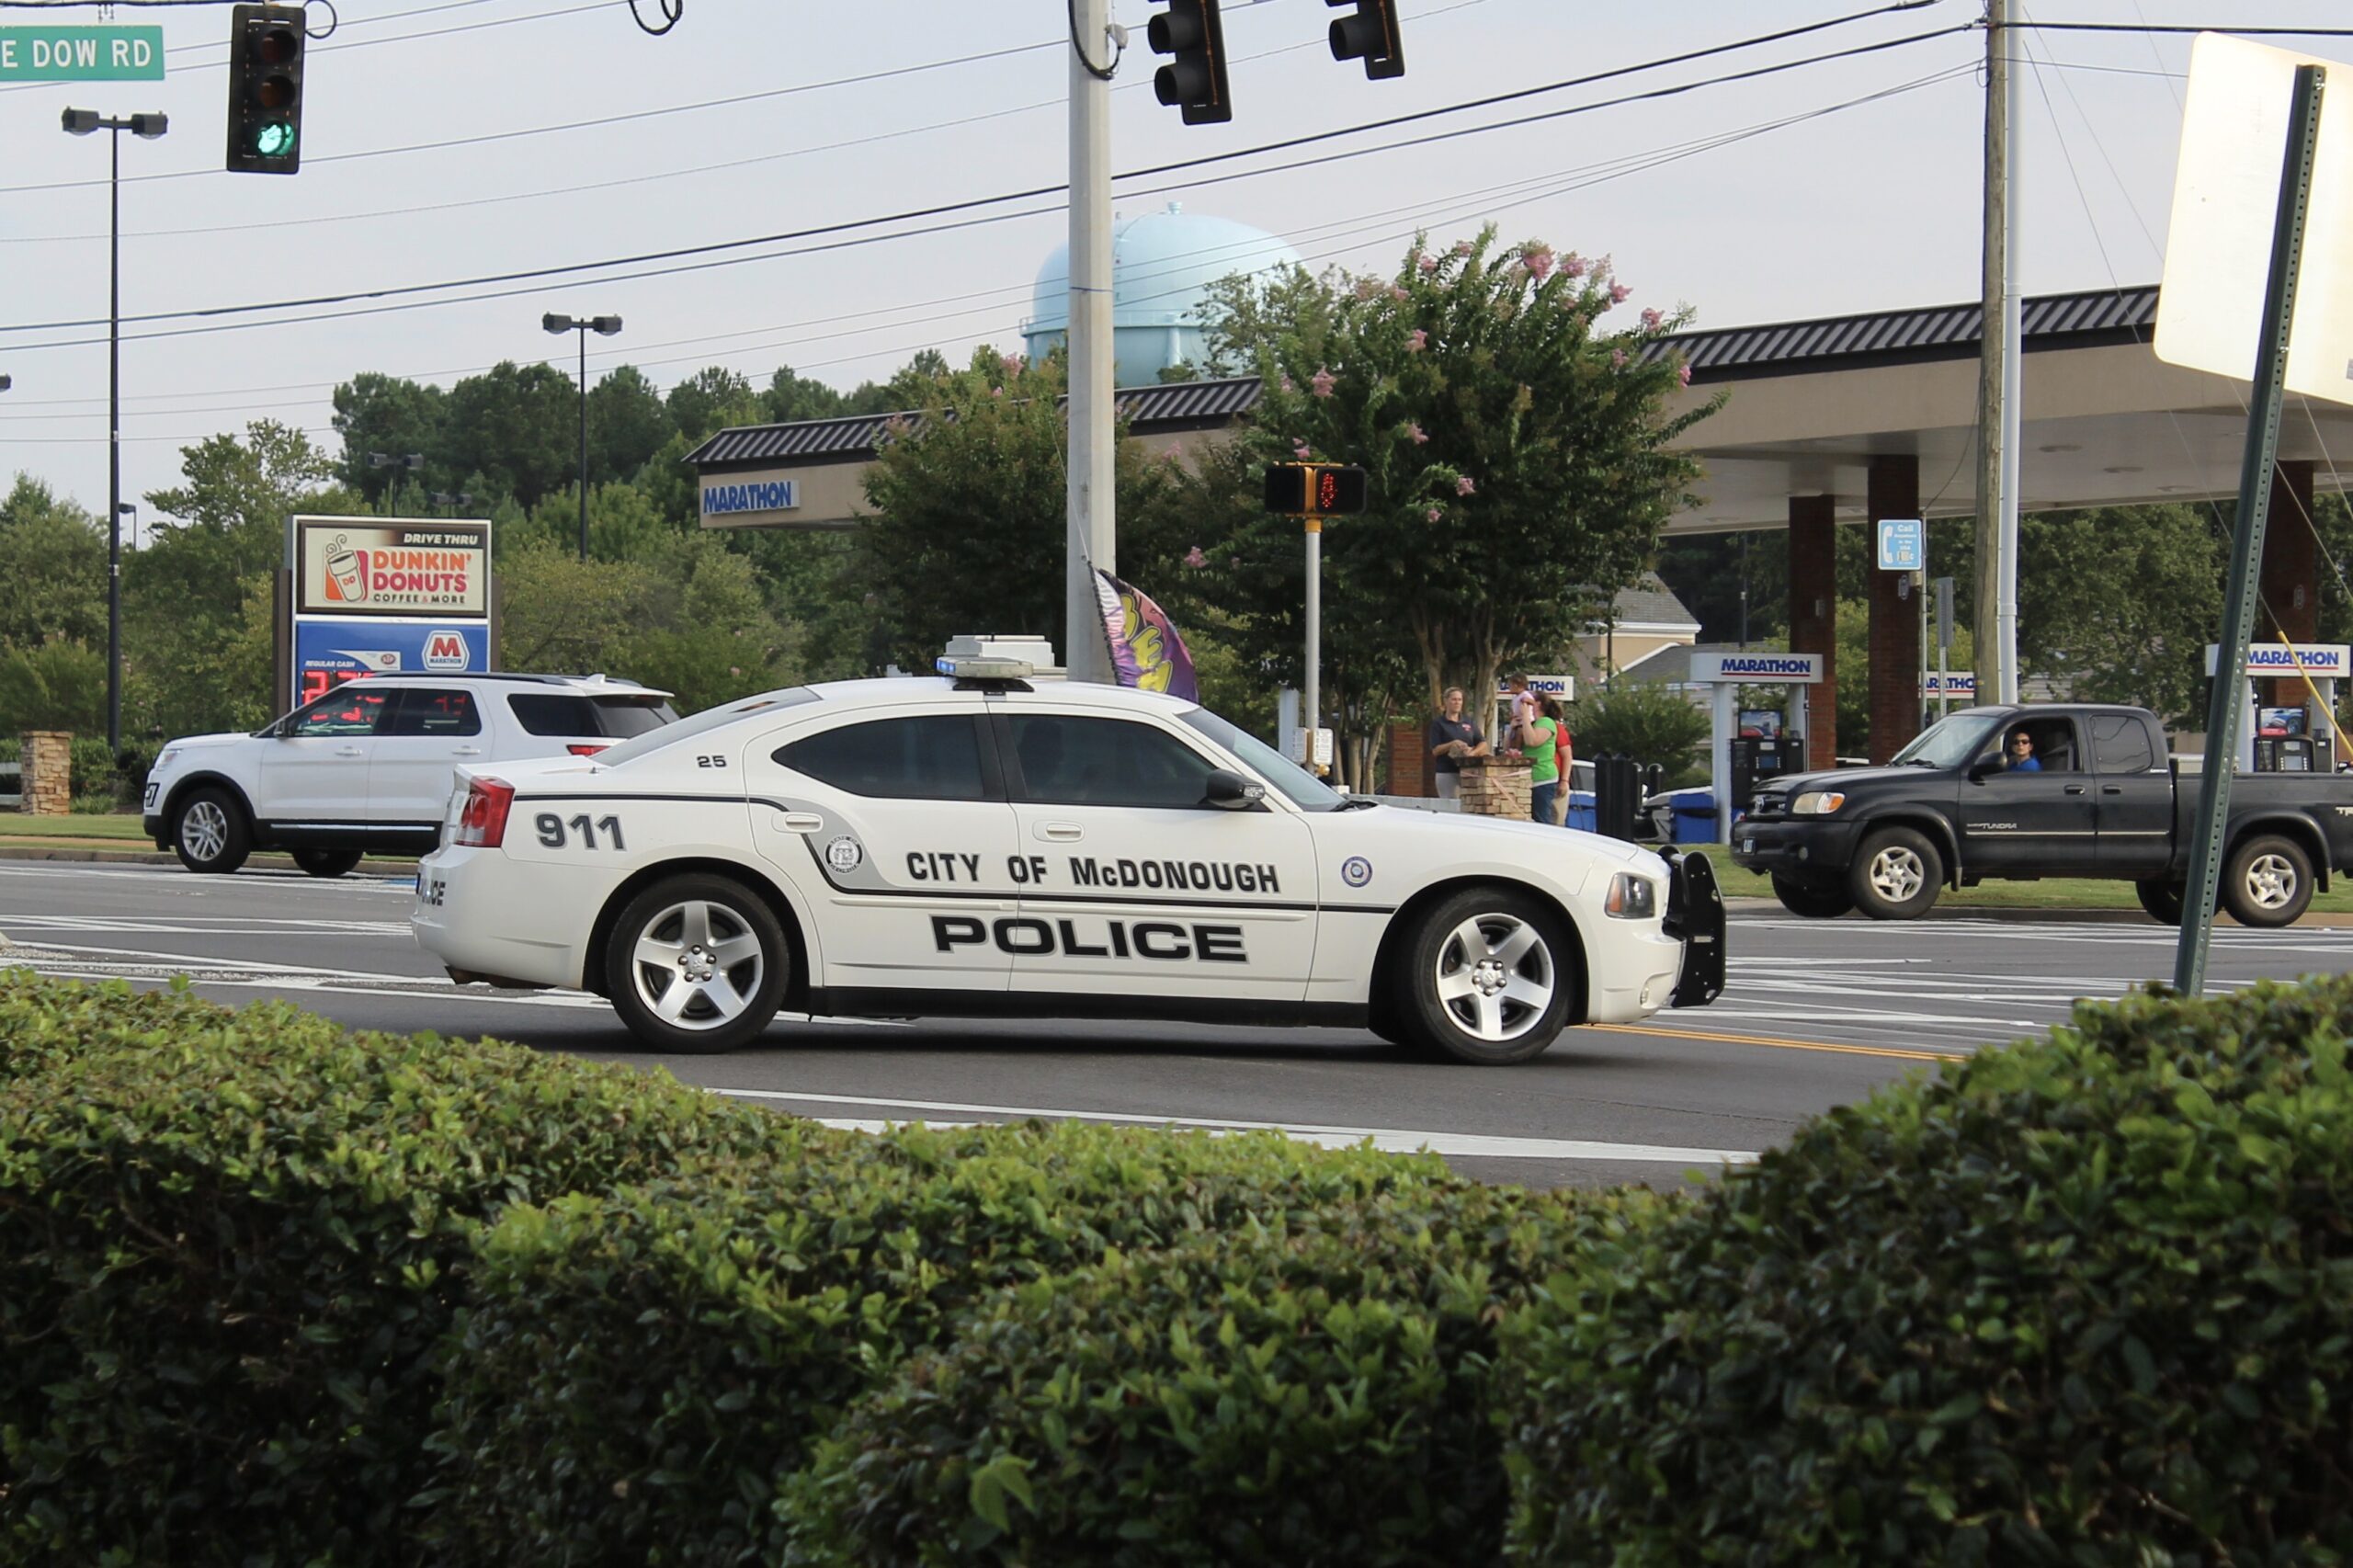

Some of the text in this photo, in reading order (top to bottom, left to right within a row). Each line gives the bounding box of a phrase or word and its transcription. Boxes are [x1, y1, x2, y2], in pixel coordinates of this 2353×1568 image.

[1, 40, 152, 68] E DOW RD
[703, 481, 791, 513] MARATHON
[404, 533, 478, 545] DRIVE THRU
[373, 551, 472, 572] DUNKIN'
[373, 572, 467, 593] DONUTS
[373, 594, 419, 603] COFFEE
[431, 596, 465, 604] MORE
[1721, 658, 1811, 673] MARATHON
[697, 756, 727, 767] 25
[534, 812, 627, 851] 911
[905, 852, 1281, 894] CITY OF McDONOUGH
[928, 915, 1250, 965] POLICE
